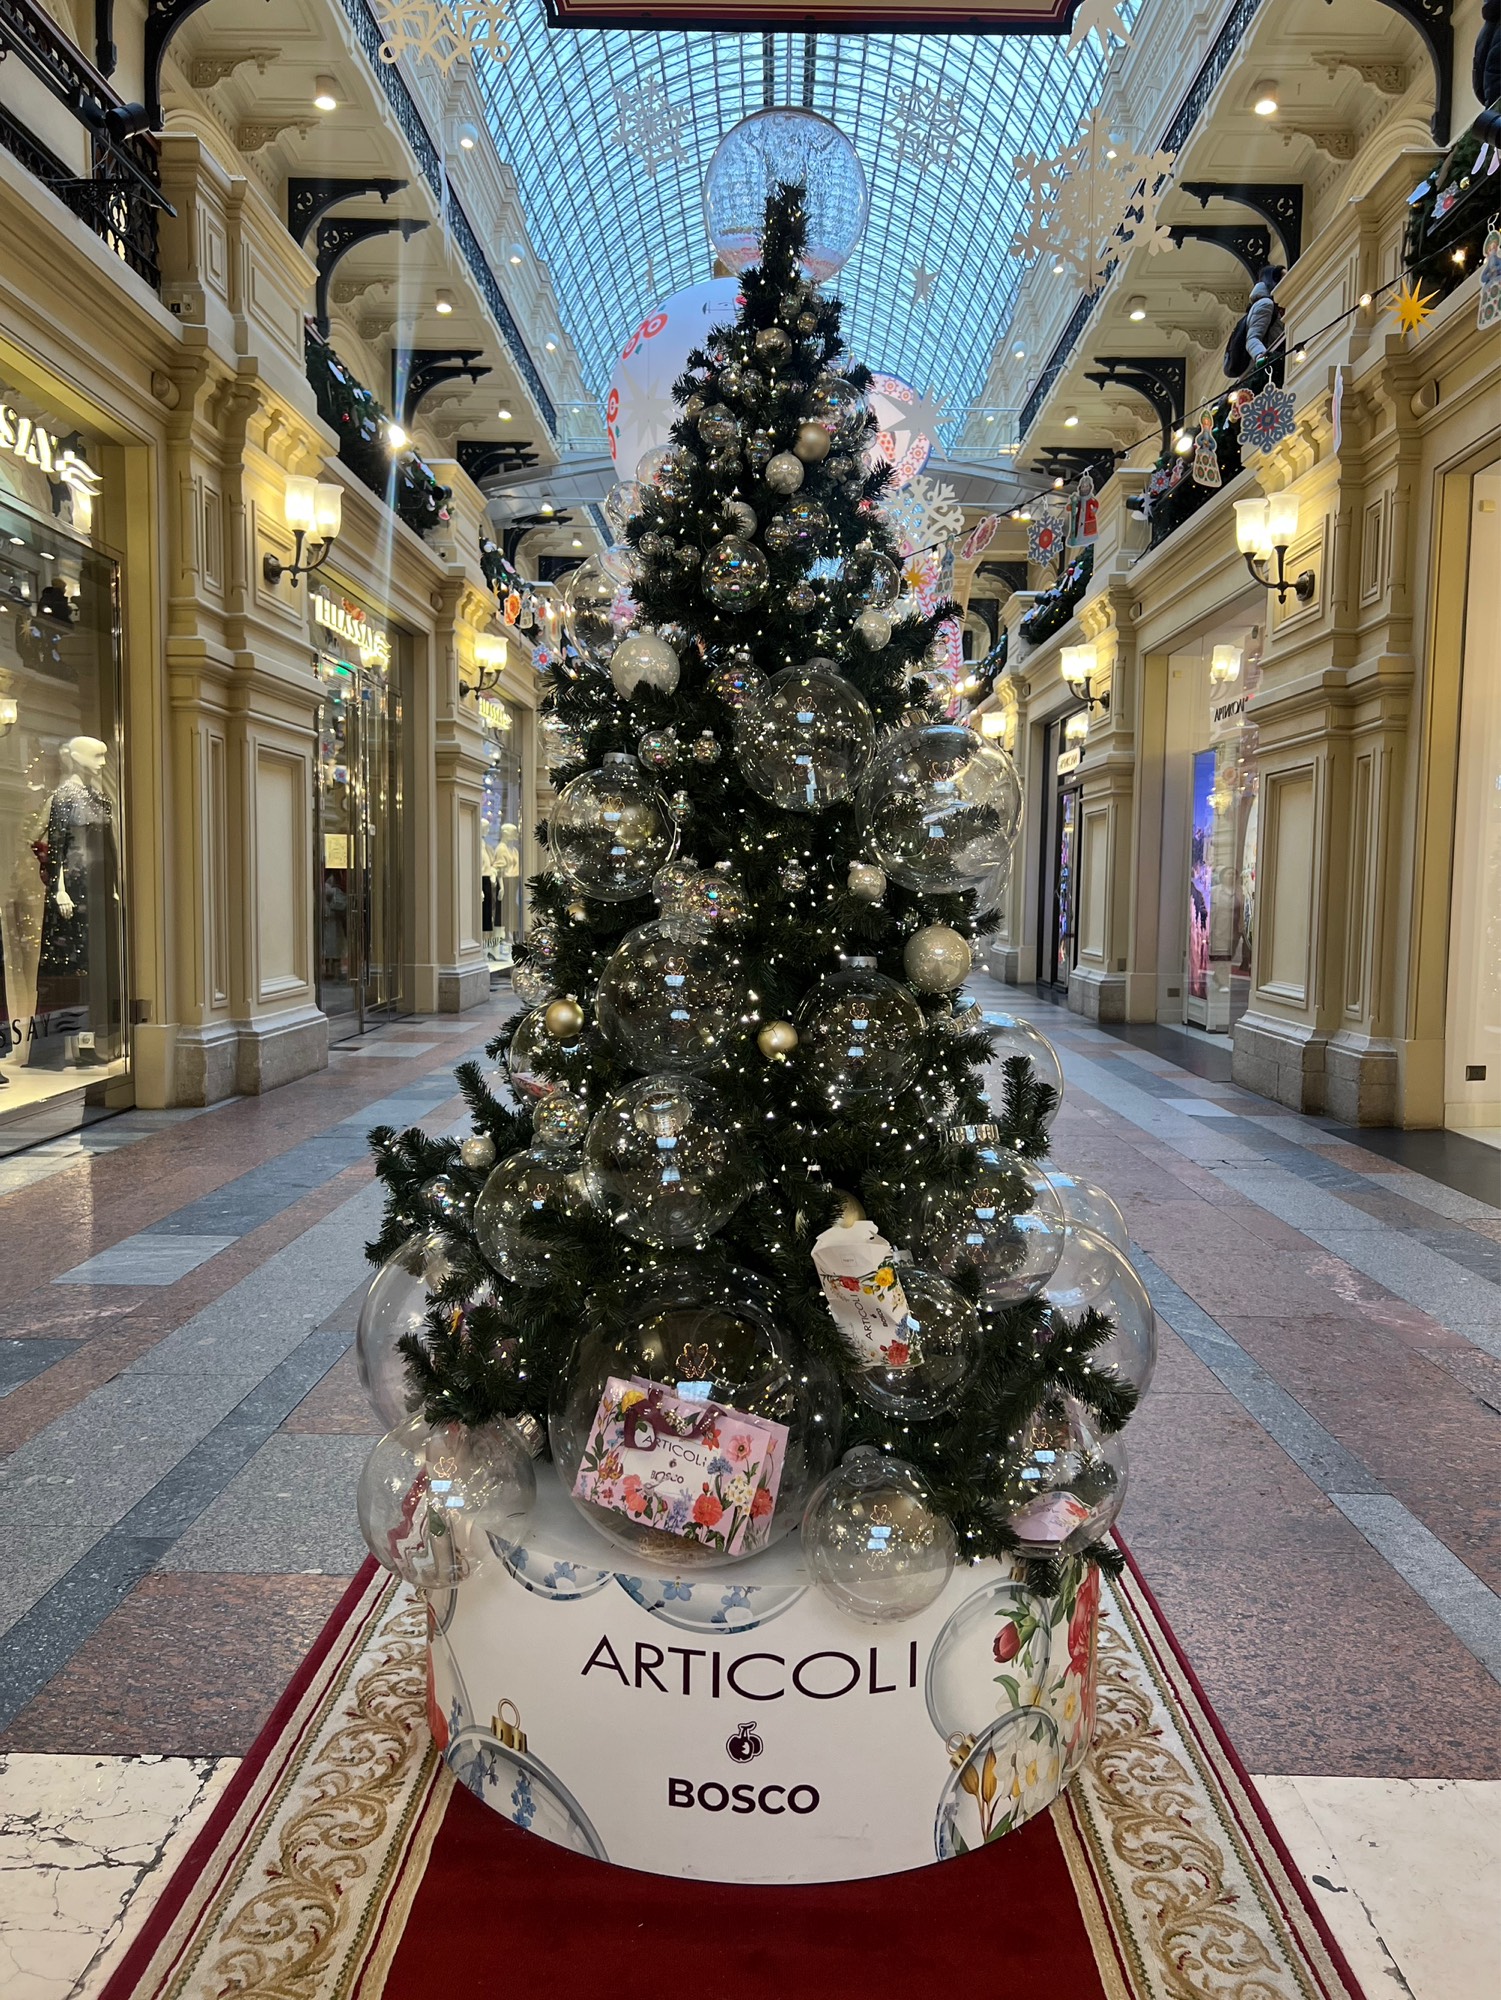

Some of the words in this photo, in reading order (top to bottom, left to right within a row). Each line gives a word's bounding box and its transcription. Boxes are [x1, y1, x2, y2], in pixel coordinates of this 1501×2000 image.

[1213, 696, 1249, 723] АРТИКОЛ
[854, 1293, 874, 1341] ARTICOLI
[580, 1634, 918, 1702] ARTICOLI
[667, 1776, 821, 1815] BOSCO
